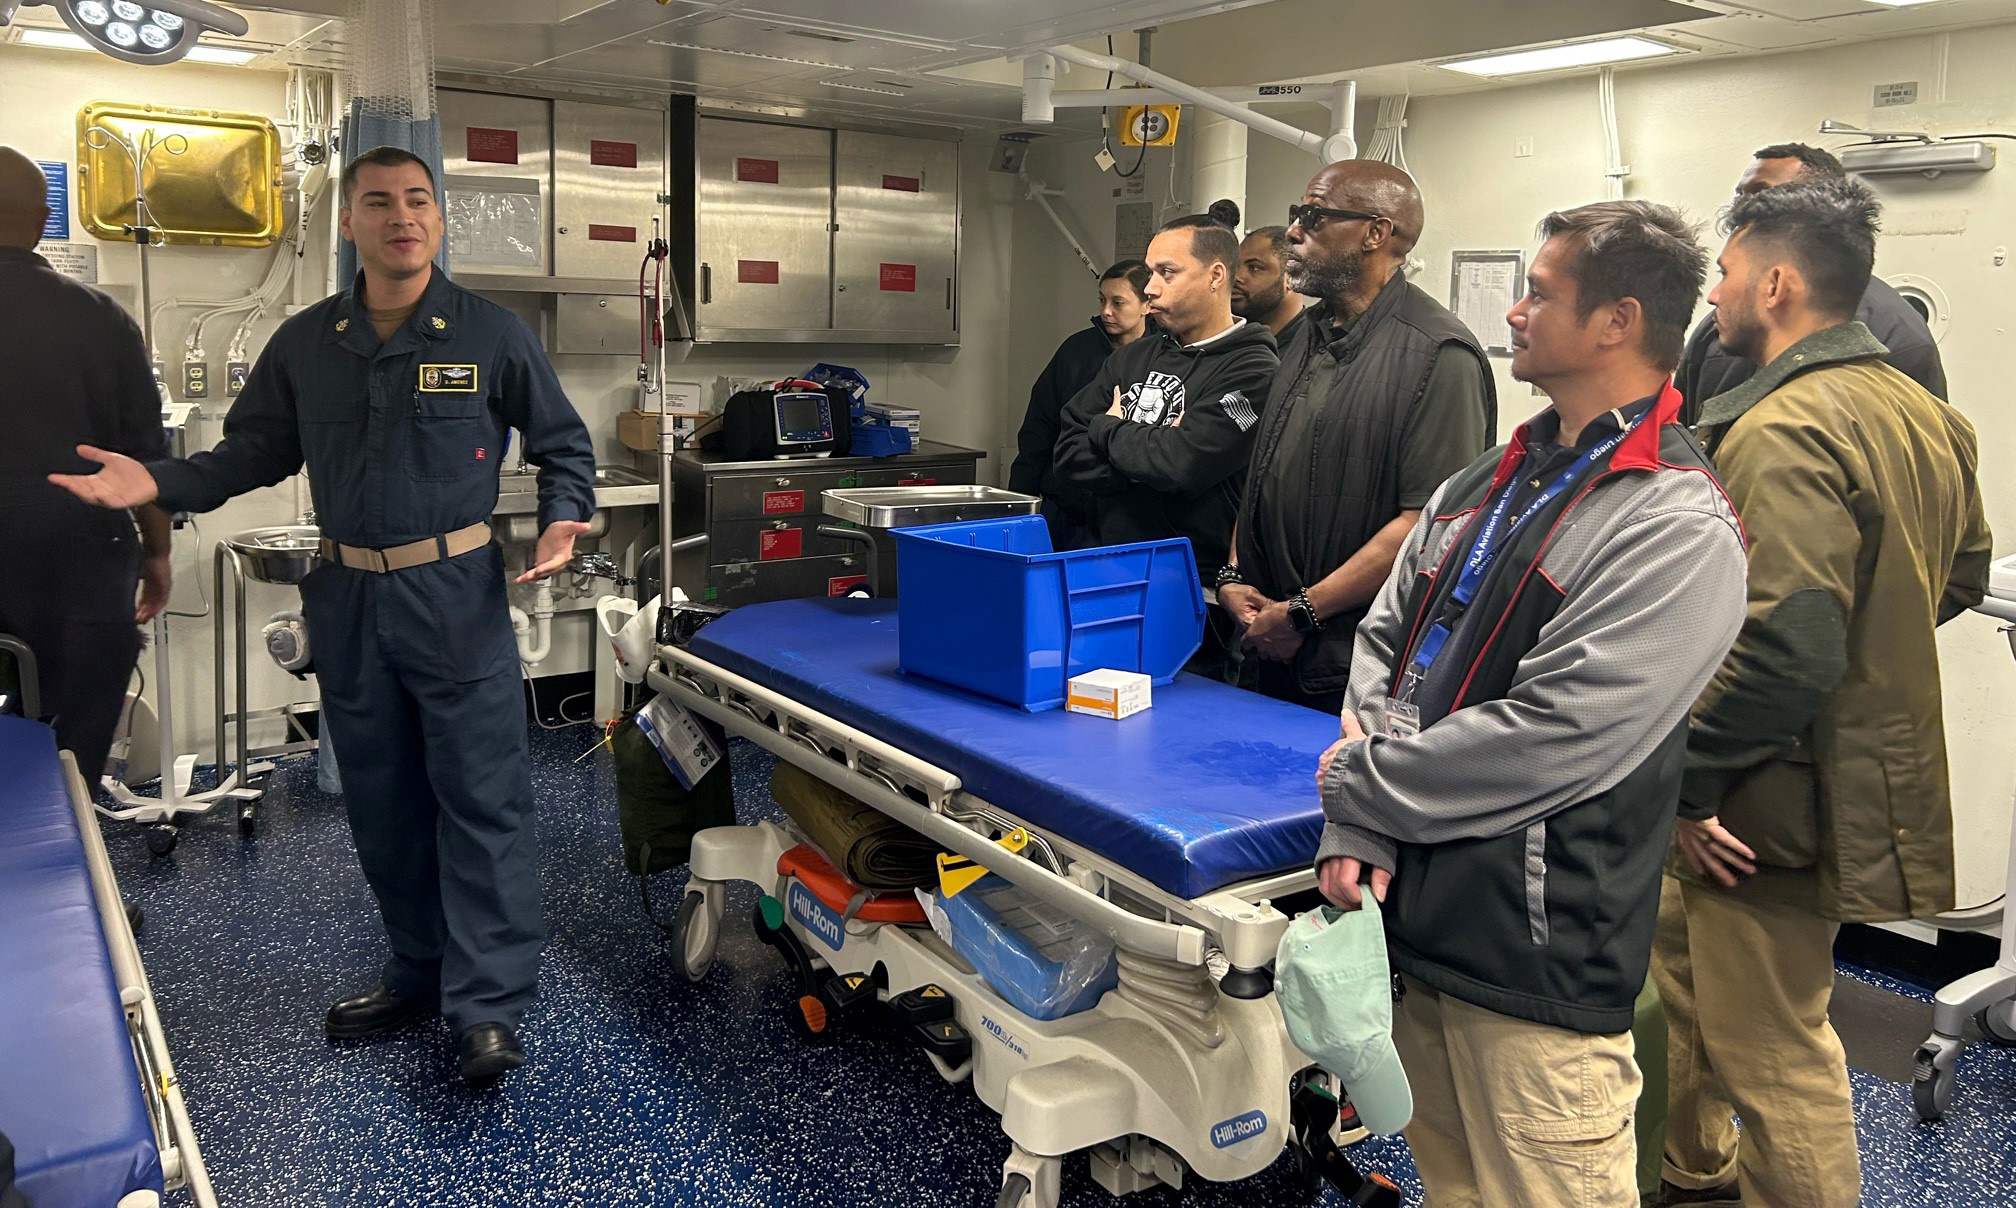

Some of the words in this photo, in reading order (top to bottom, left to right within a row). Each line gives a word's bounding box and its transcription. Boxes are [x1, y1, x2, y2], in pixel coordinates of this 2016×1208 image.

[1280, 86, 1302, 95] 550
[39, 245, 70, 253] WARNING
[1589, 439, 1615, 460] Diego
[1531, 493, 1549, 509] DLA
[1469, 549, 1485, 568] DLA
[1478, 515, 1499, 550] Aviation
[1493, 498, 1506, 515] San
[793, 889, 839, 942] Hill-Rom
[1214, 1117, 1263, 1144] Hill-Rom
